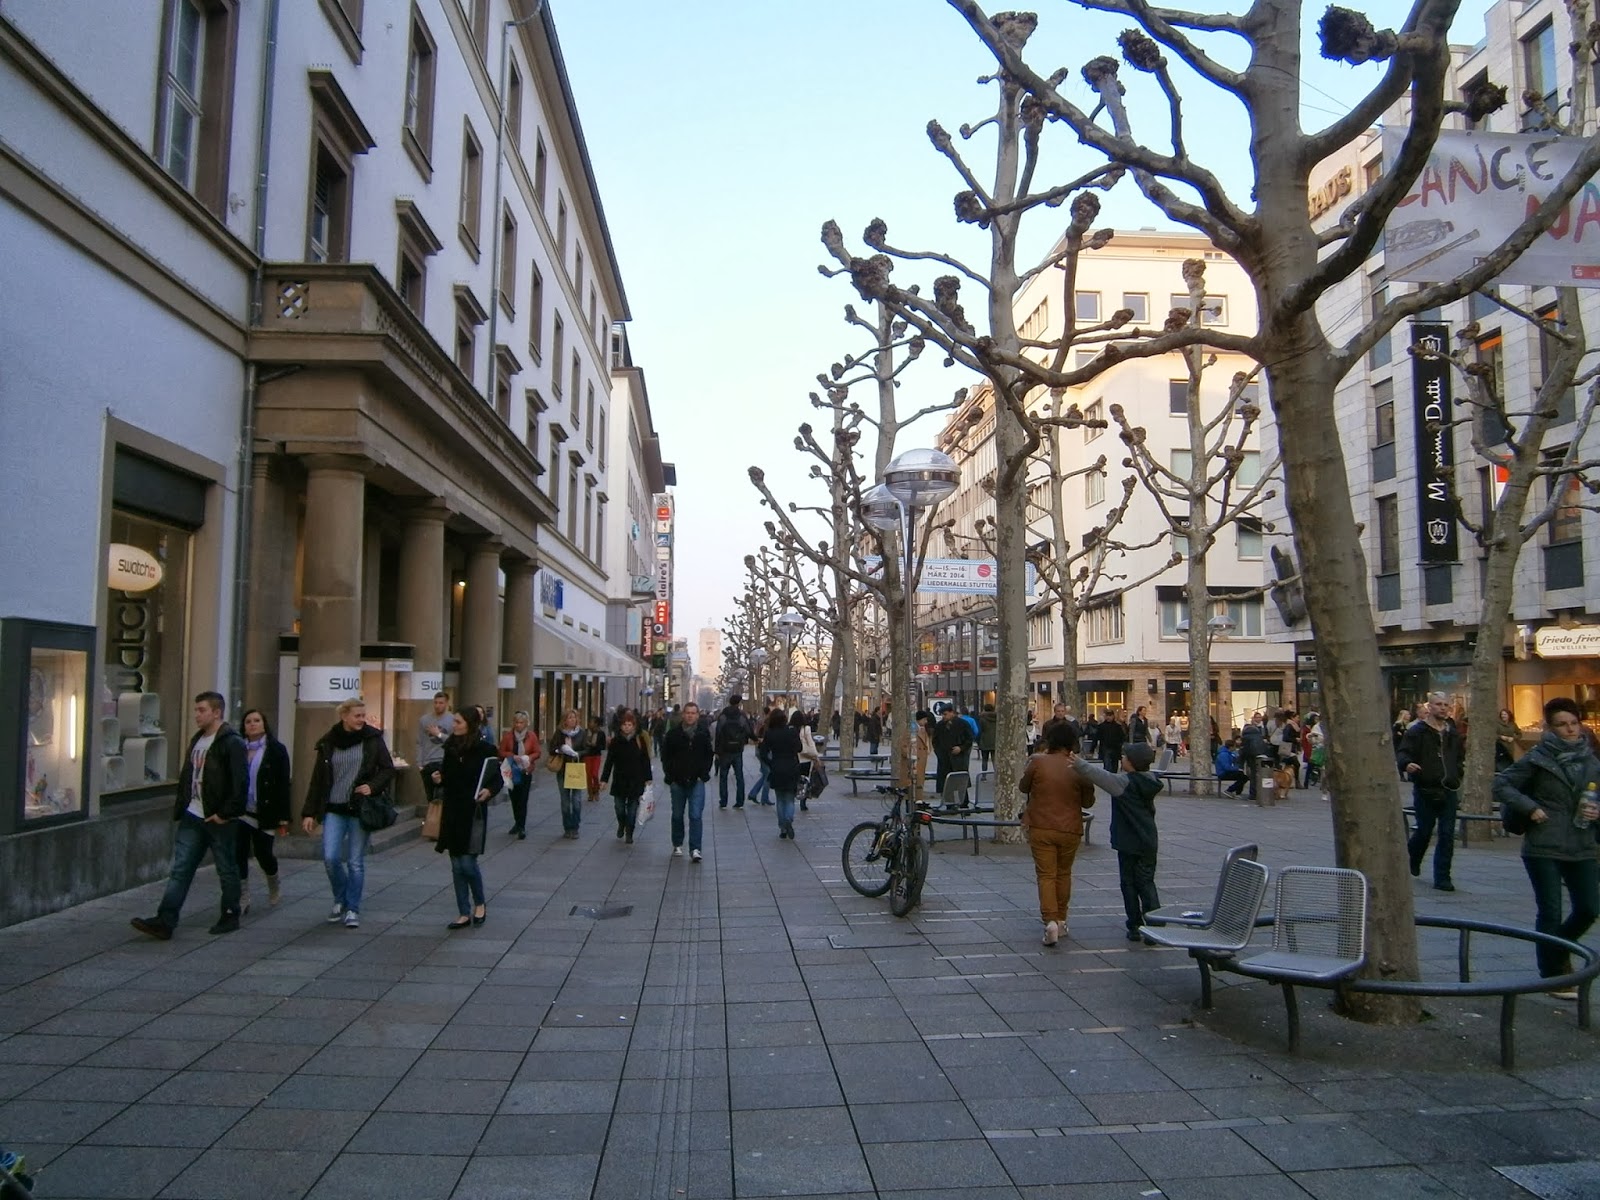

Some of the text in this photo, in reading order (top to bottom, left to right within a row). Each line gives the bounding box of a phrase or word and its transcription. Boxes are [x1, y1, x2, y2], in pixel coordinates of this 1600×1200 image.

[1394, 140, 1560, 208] ANCE
[1425, 377, 1446, 502] Mssim Dutti
[118, 558, 150, 577] swatch
[658, 562, 667, 598] claire's
[1538, 636, 1572, 646] friedo
